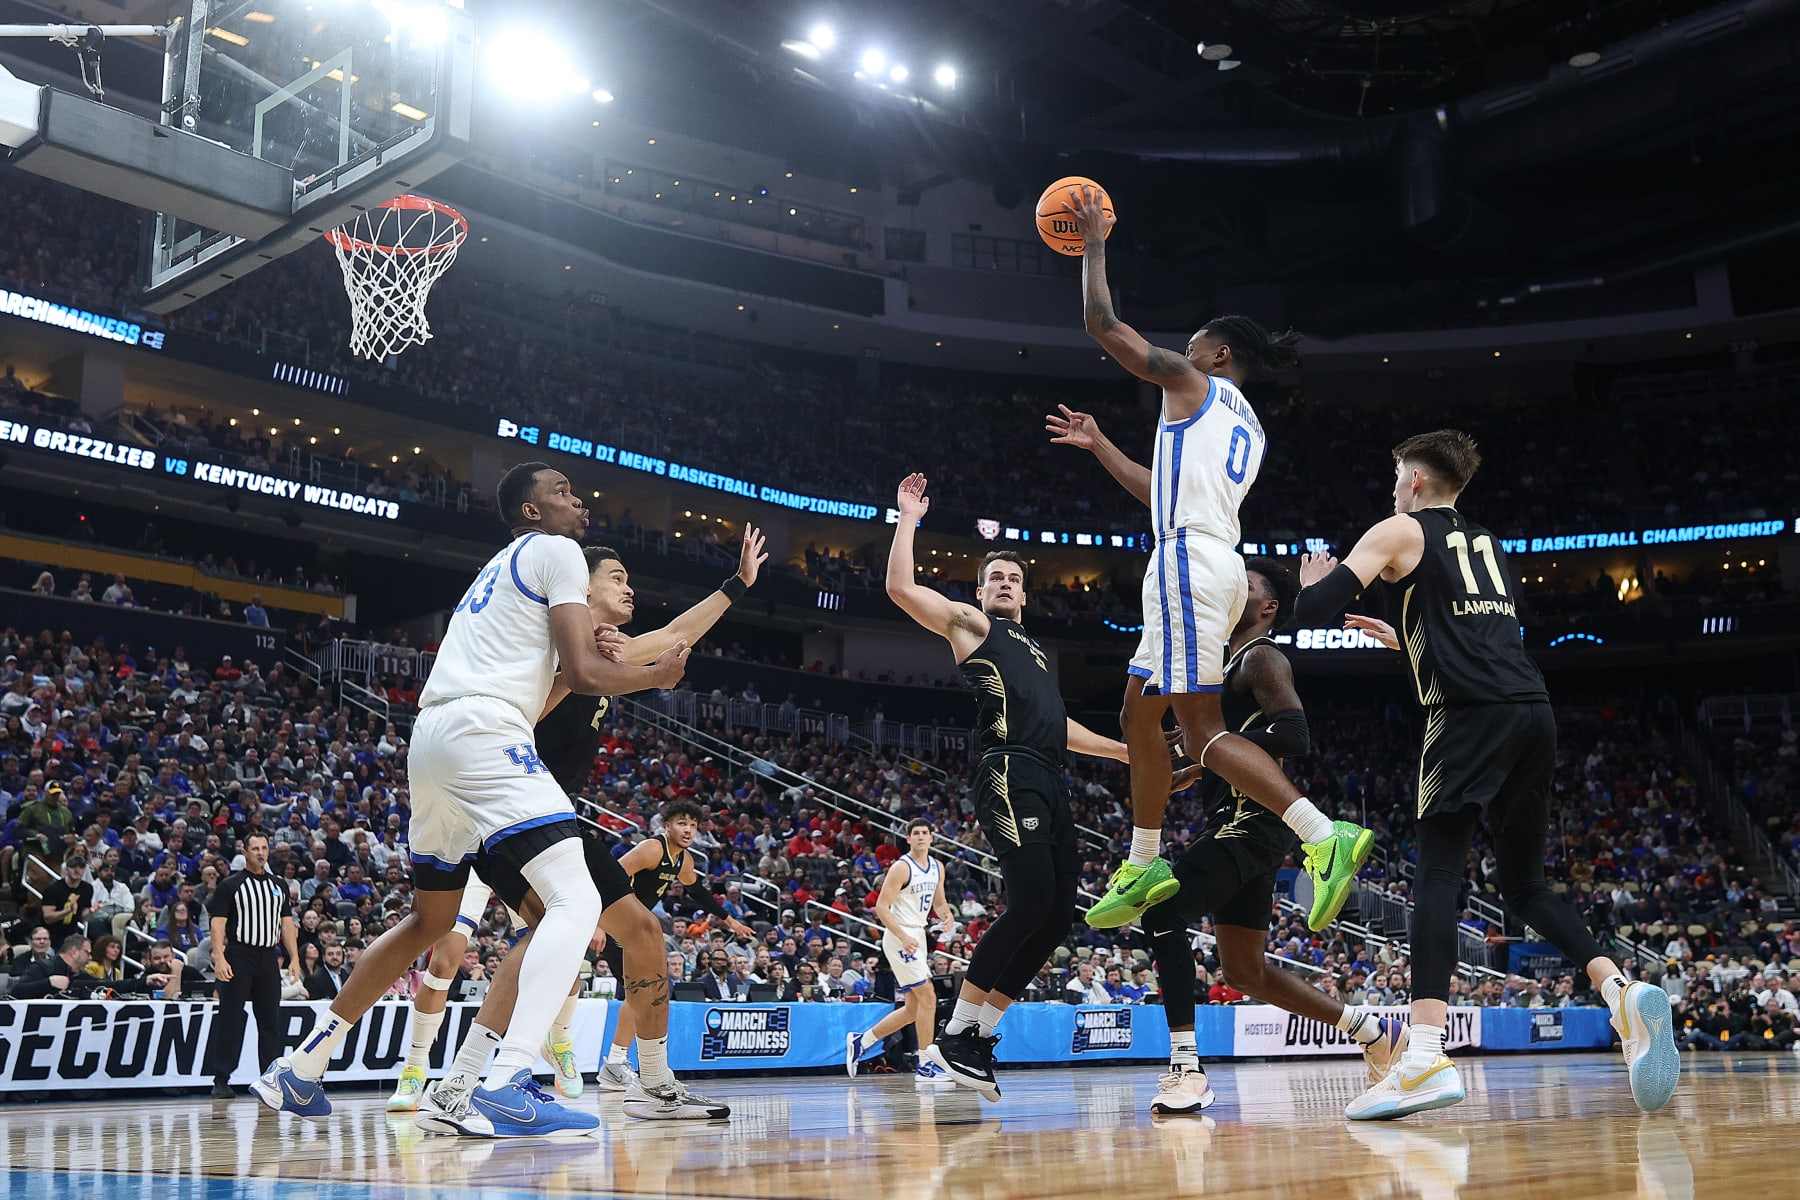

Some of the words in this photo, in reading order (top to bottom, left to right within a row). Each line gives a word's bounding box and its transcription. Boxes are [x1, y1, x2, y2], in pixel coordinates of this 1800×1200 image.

[1052, 220, 1079, 234] Wil
[1061, 244, 1085, 253] NC
[1226, 425, 1251, 485] 0
[33, 428, 156, 469] GRIZZLIES
[164, 457, 188, 475] VS
[194, 462, 301, 499] KENTUCKY
[304, 484, 400, 519] WILDCATS
[548, 432, 593, 458] 2024
[595, 444, 616, 463] DI
[618, 450, 668, 476] MEN'S
[668, 463, 758, 498] BASKETBALL
[760, 486, 878, 520] CHAMPIONSHIP
[1531, 531, 1638, 552] BASKETBALL
[1642, 520, 1785, 545] CHAMPIONSHIP
[1445, 531, 1507, 597] 11
[255, 634, 276, 650] 112
[382, 655, 411, 676] 113
[591, 696, 609, 732] 2
[701, 703, 723, 720] 114
[804, 718, 825, 734] 114
[943, 735, 965, 750] 115
[919, 893, 932, 913] 15
[721, 1012, 768, 1030] MARCH
[1084, 1013, 1116, 1029] MARCH
[1245, 1024, 1273, 1035] HOSTED
[727, 1031, 789, 1050] MADNESS
[1089, 1028, 1131, 1044] MADNESS
